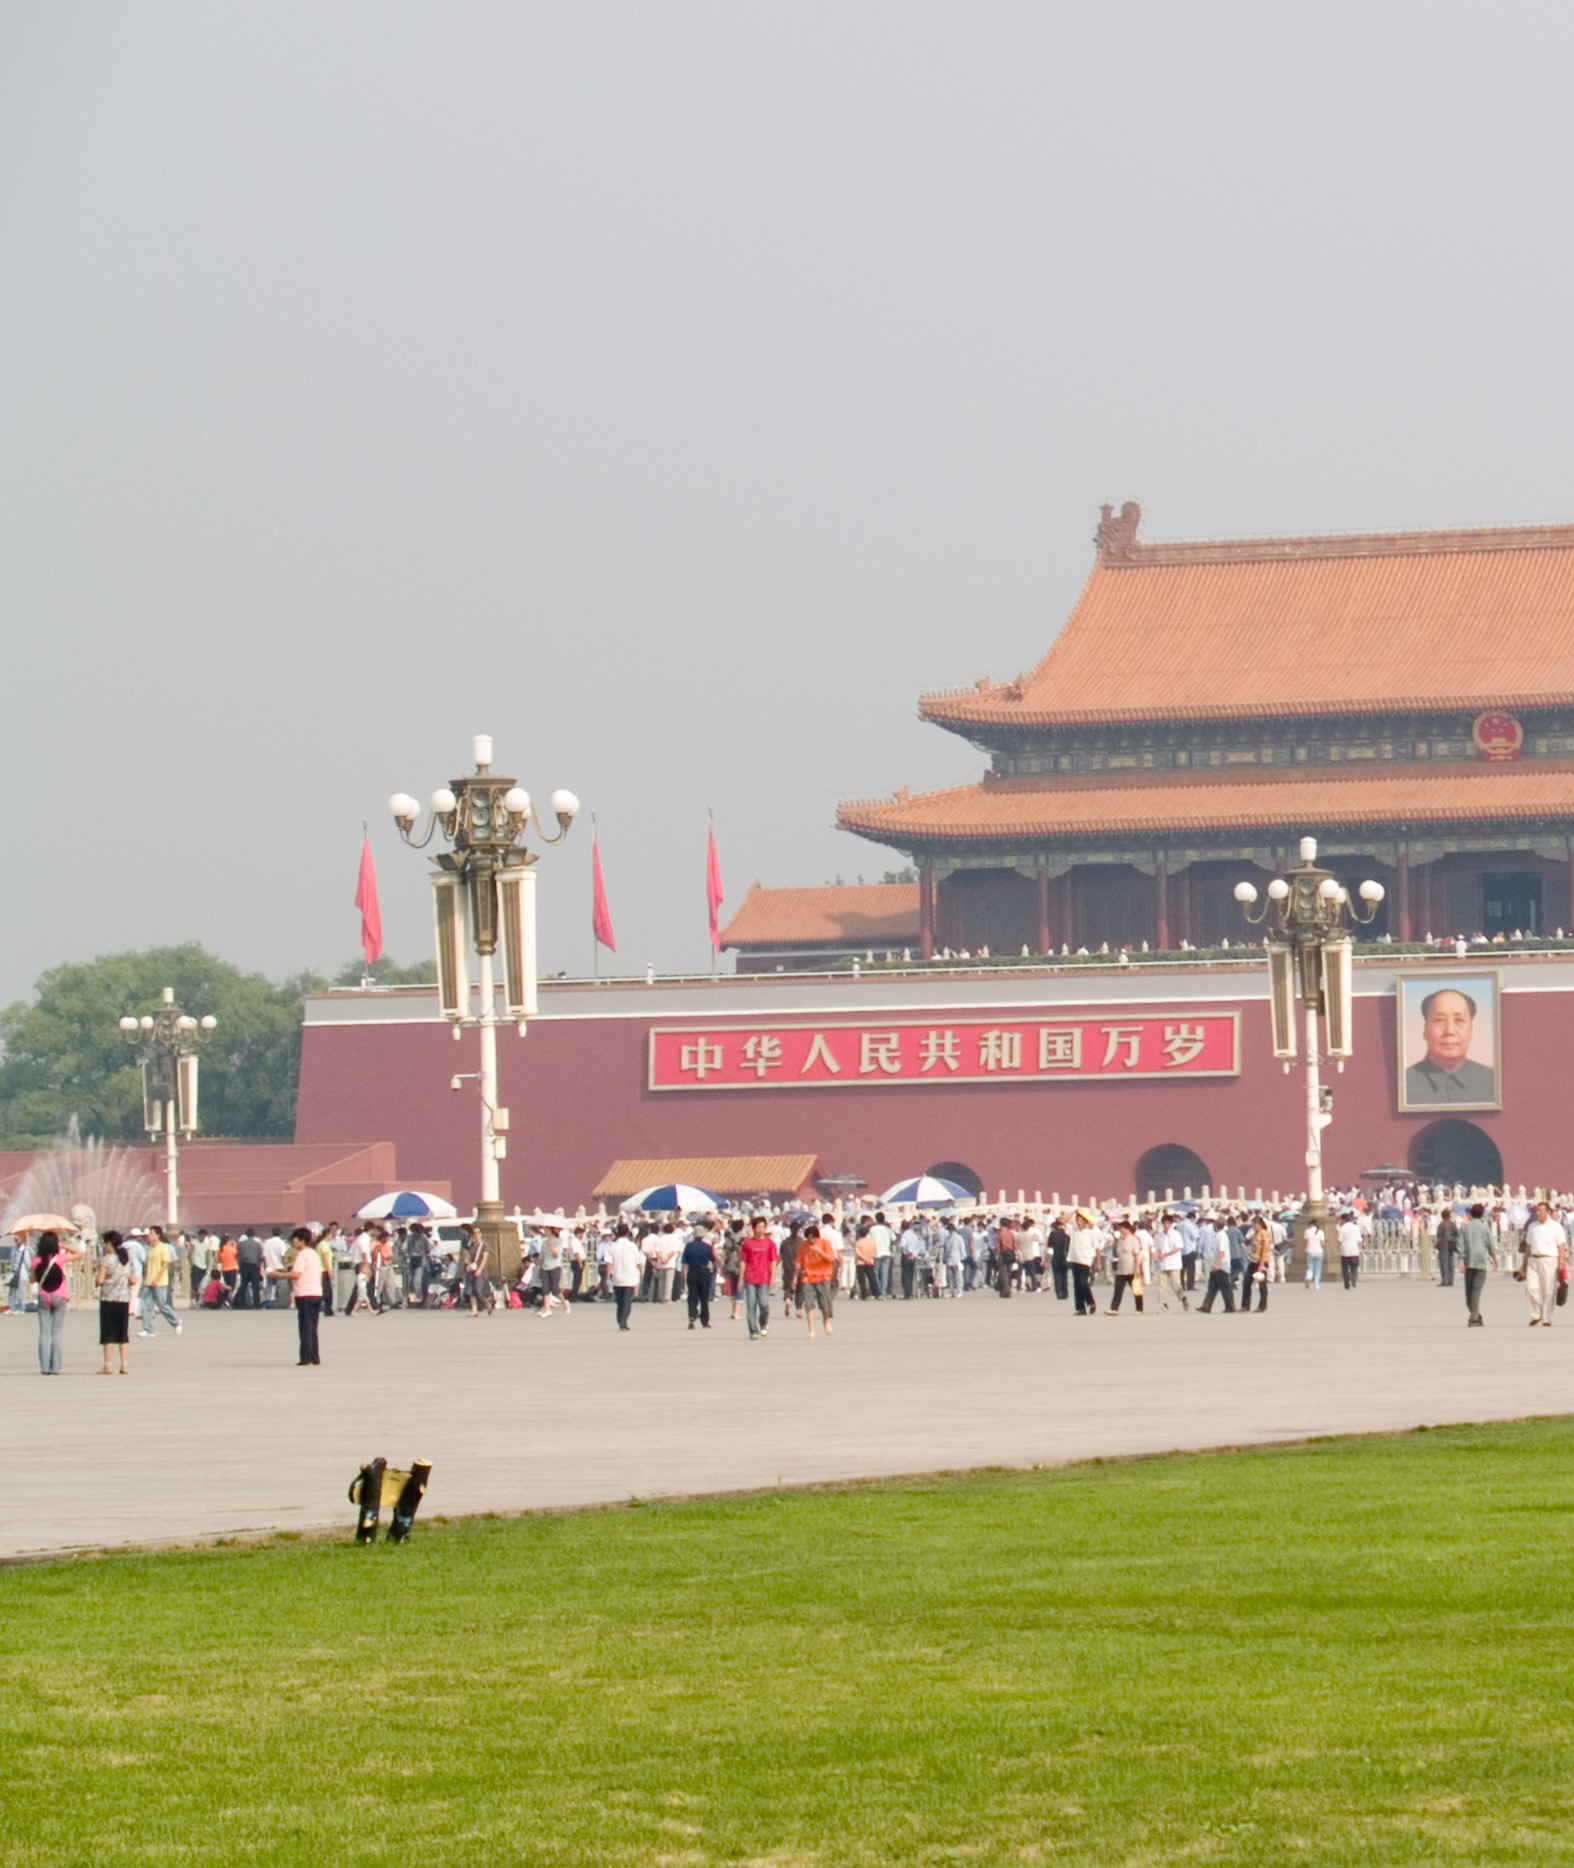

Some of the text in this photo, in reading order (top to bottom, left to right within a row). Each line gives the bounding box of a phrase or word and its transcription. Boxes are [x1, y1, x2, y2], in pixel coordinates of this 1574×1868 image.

[680, 1024, 1205, 1079] 中华人民共和国万岁
